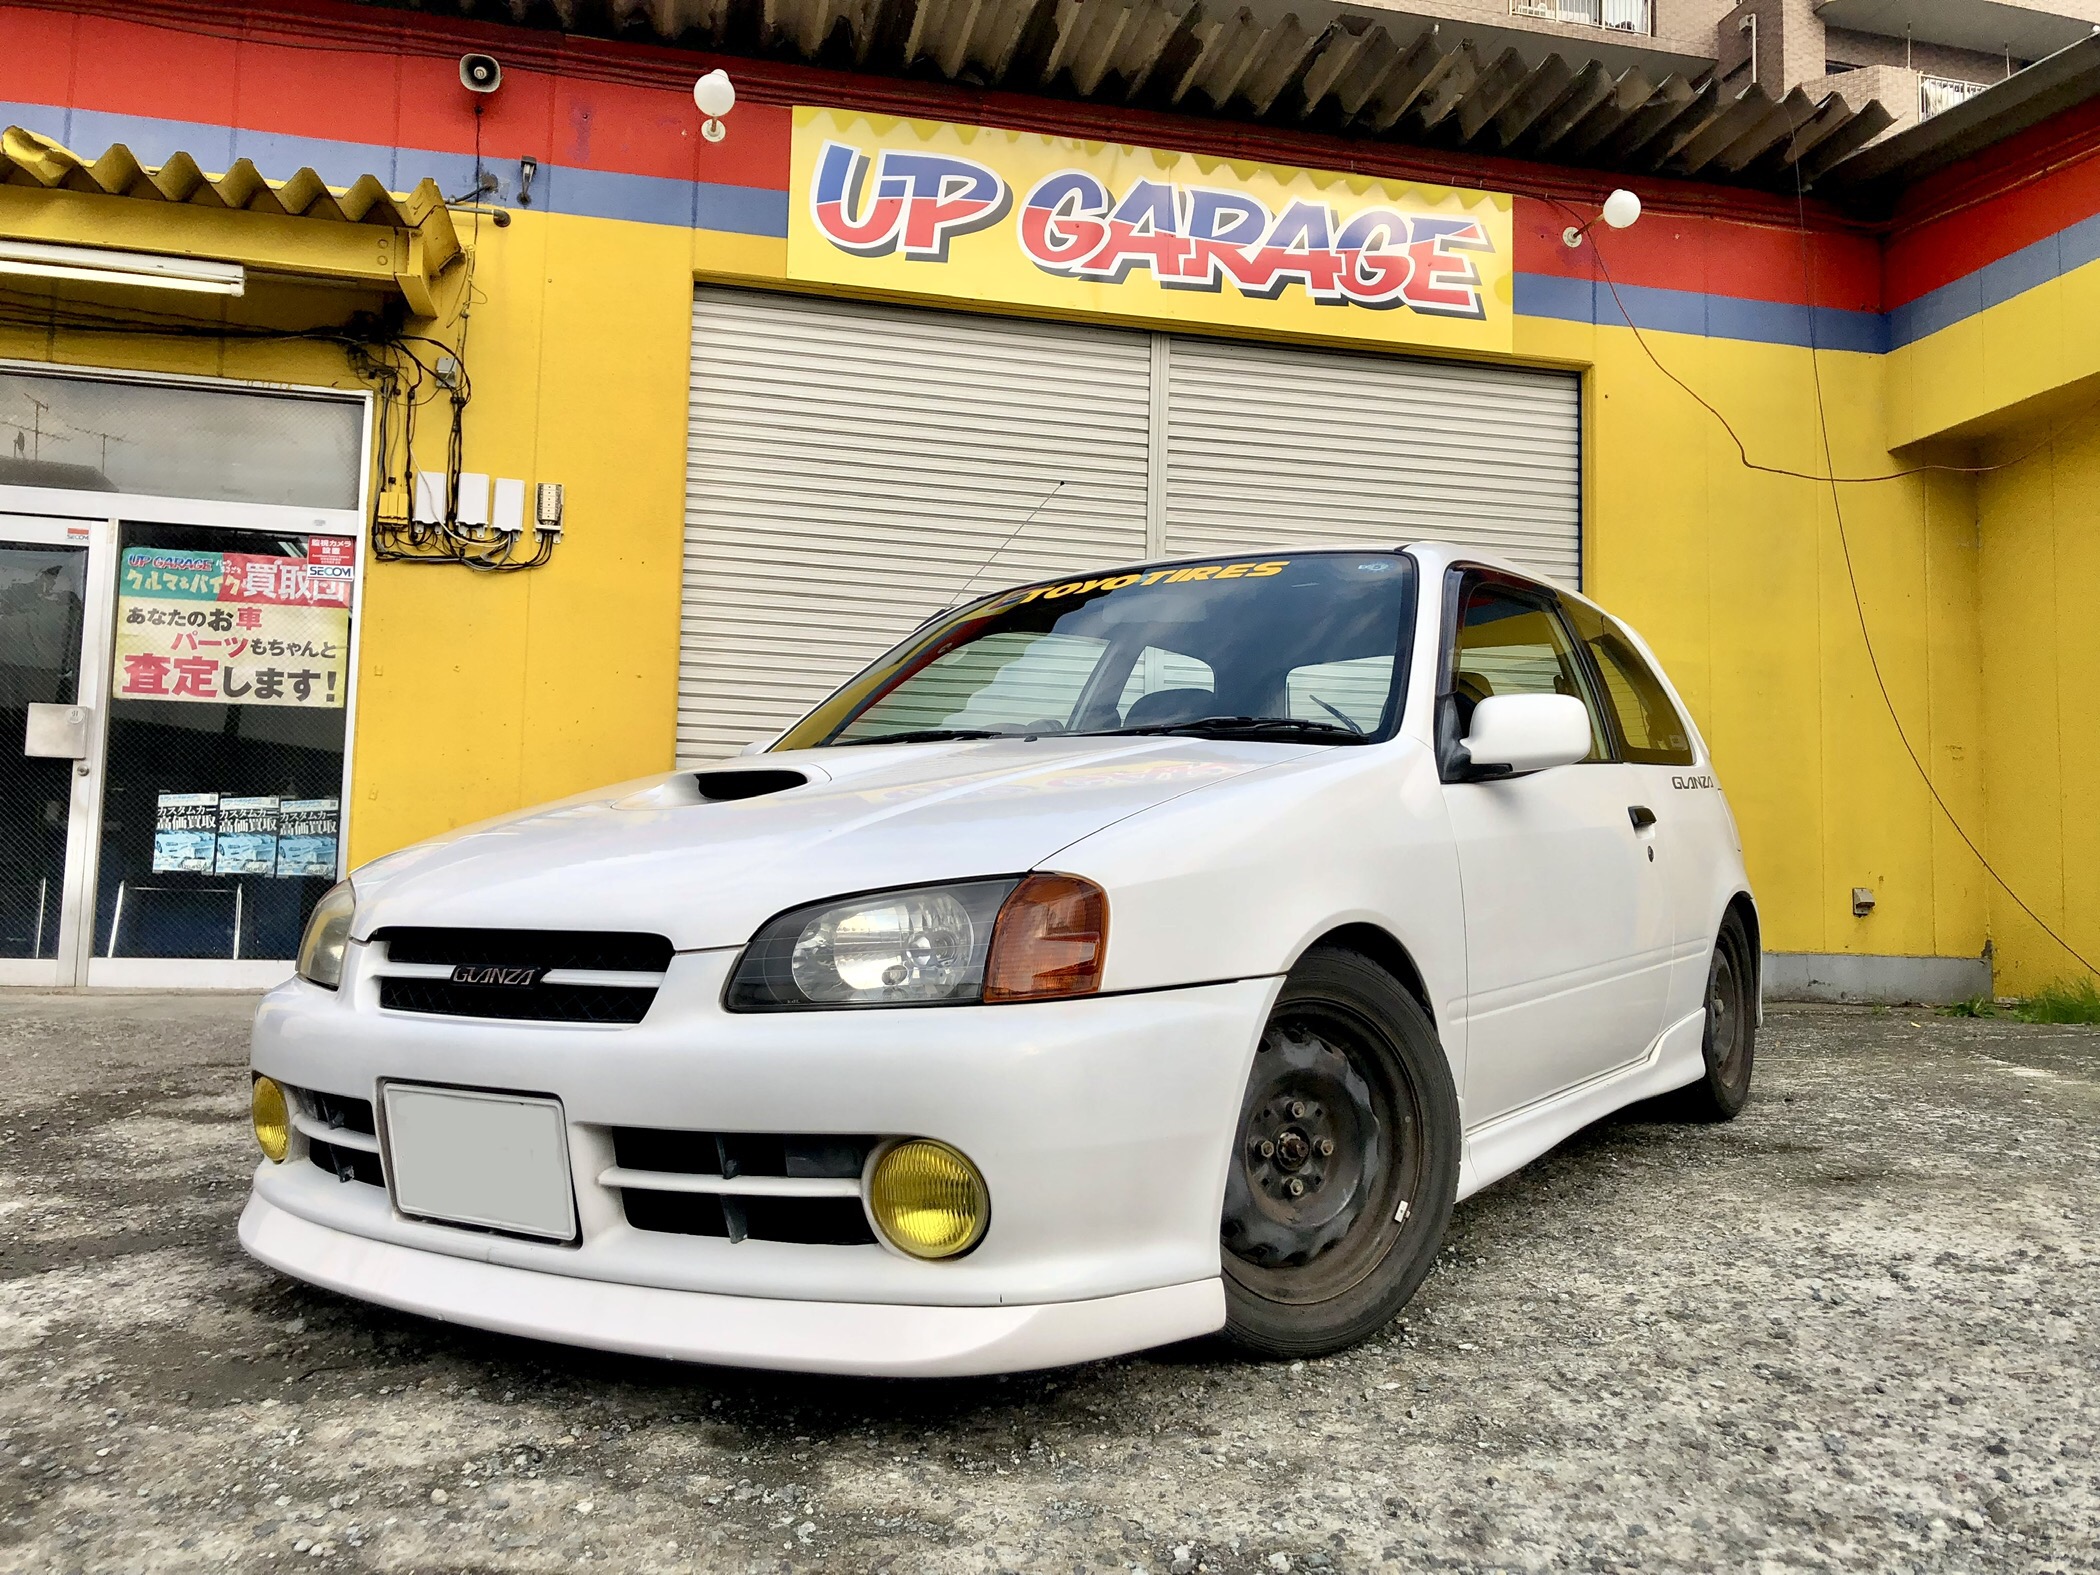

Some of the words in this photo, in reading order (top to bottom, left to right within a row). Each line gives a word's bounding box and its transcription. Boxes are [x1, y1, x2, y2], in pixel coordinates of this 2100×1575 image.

[809, 139, 1012, 262] UP
[1016, 168, 1496, 321] GARAGE
[311, 539, 352, 547] 監視カメラ
[128, 553, 152, 567] UP
[152, 556, 214, 572] GARAGE
[309, 566, 351, 577] SECOM
[1019, 573, 1142, 604] TOYO
[1140, 560, 1290, 587] TIRES
[126, 607, 263, 632] あなたのお車
[170, 630, 337, 659] パーツもちゃんと
[121, 652, 338, 703] 査定します!
[1672, 776, 1714, 789] GLANZA
[157, 806, 217, 817] カスタムカー
[219, 808, 278, 819] カスタムカー
[280, 811, 338, 823] カスタムカー
[156, 814, 217, 831] 高価買取
[218, 818, 278, 833] 高価買取
[279, 820, 338, 836] 高価買取
[453, 967, 535, 985] GLANZA
